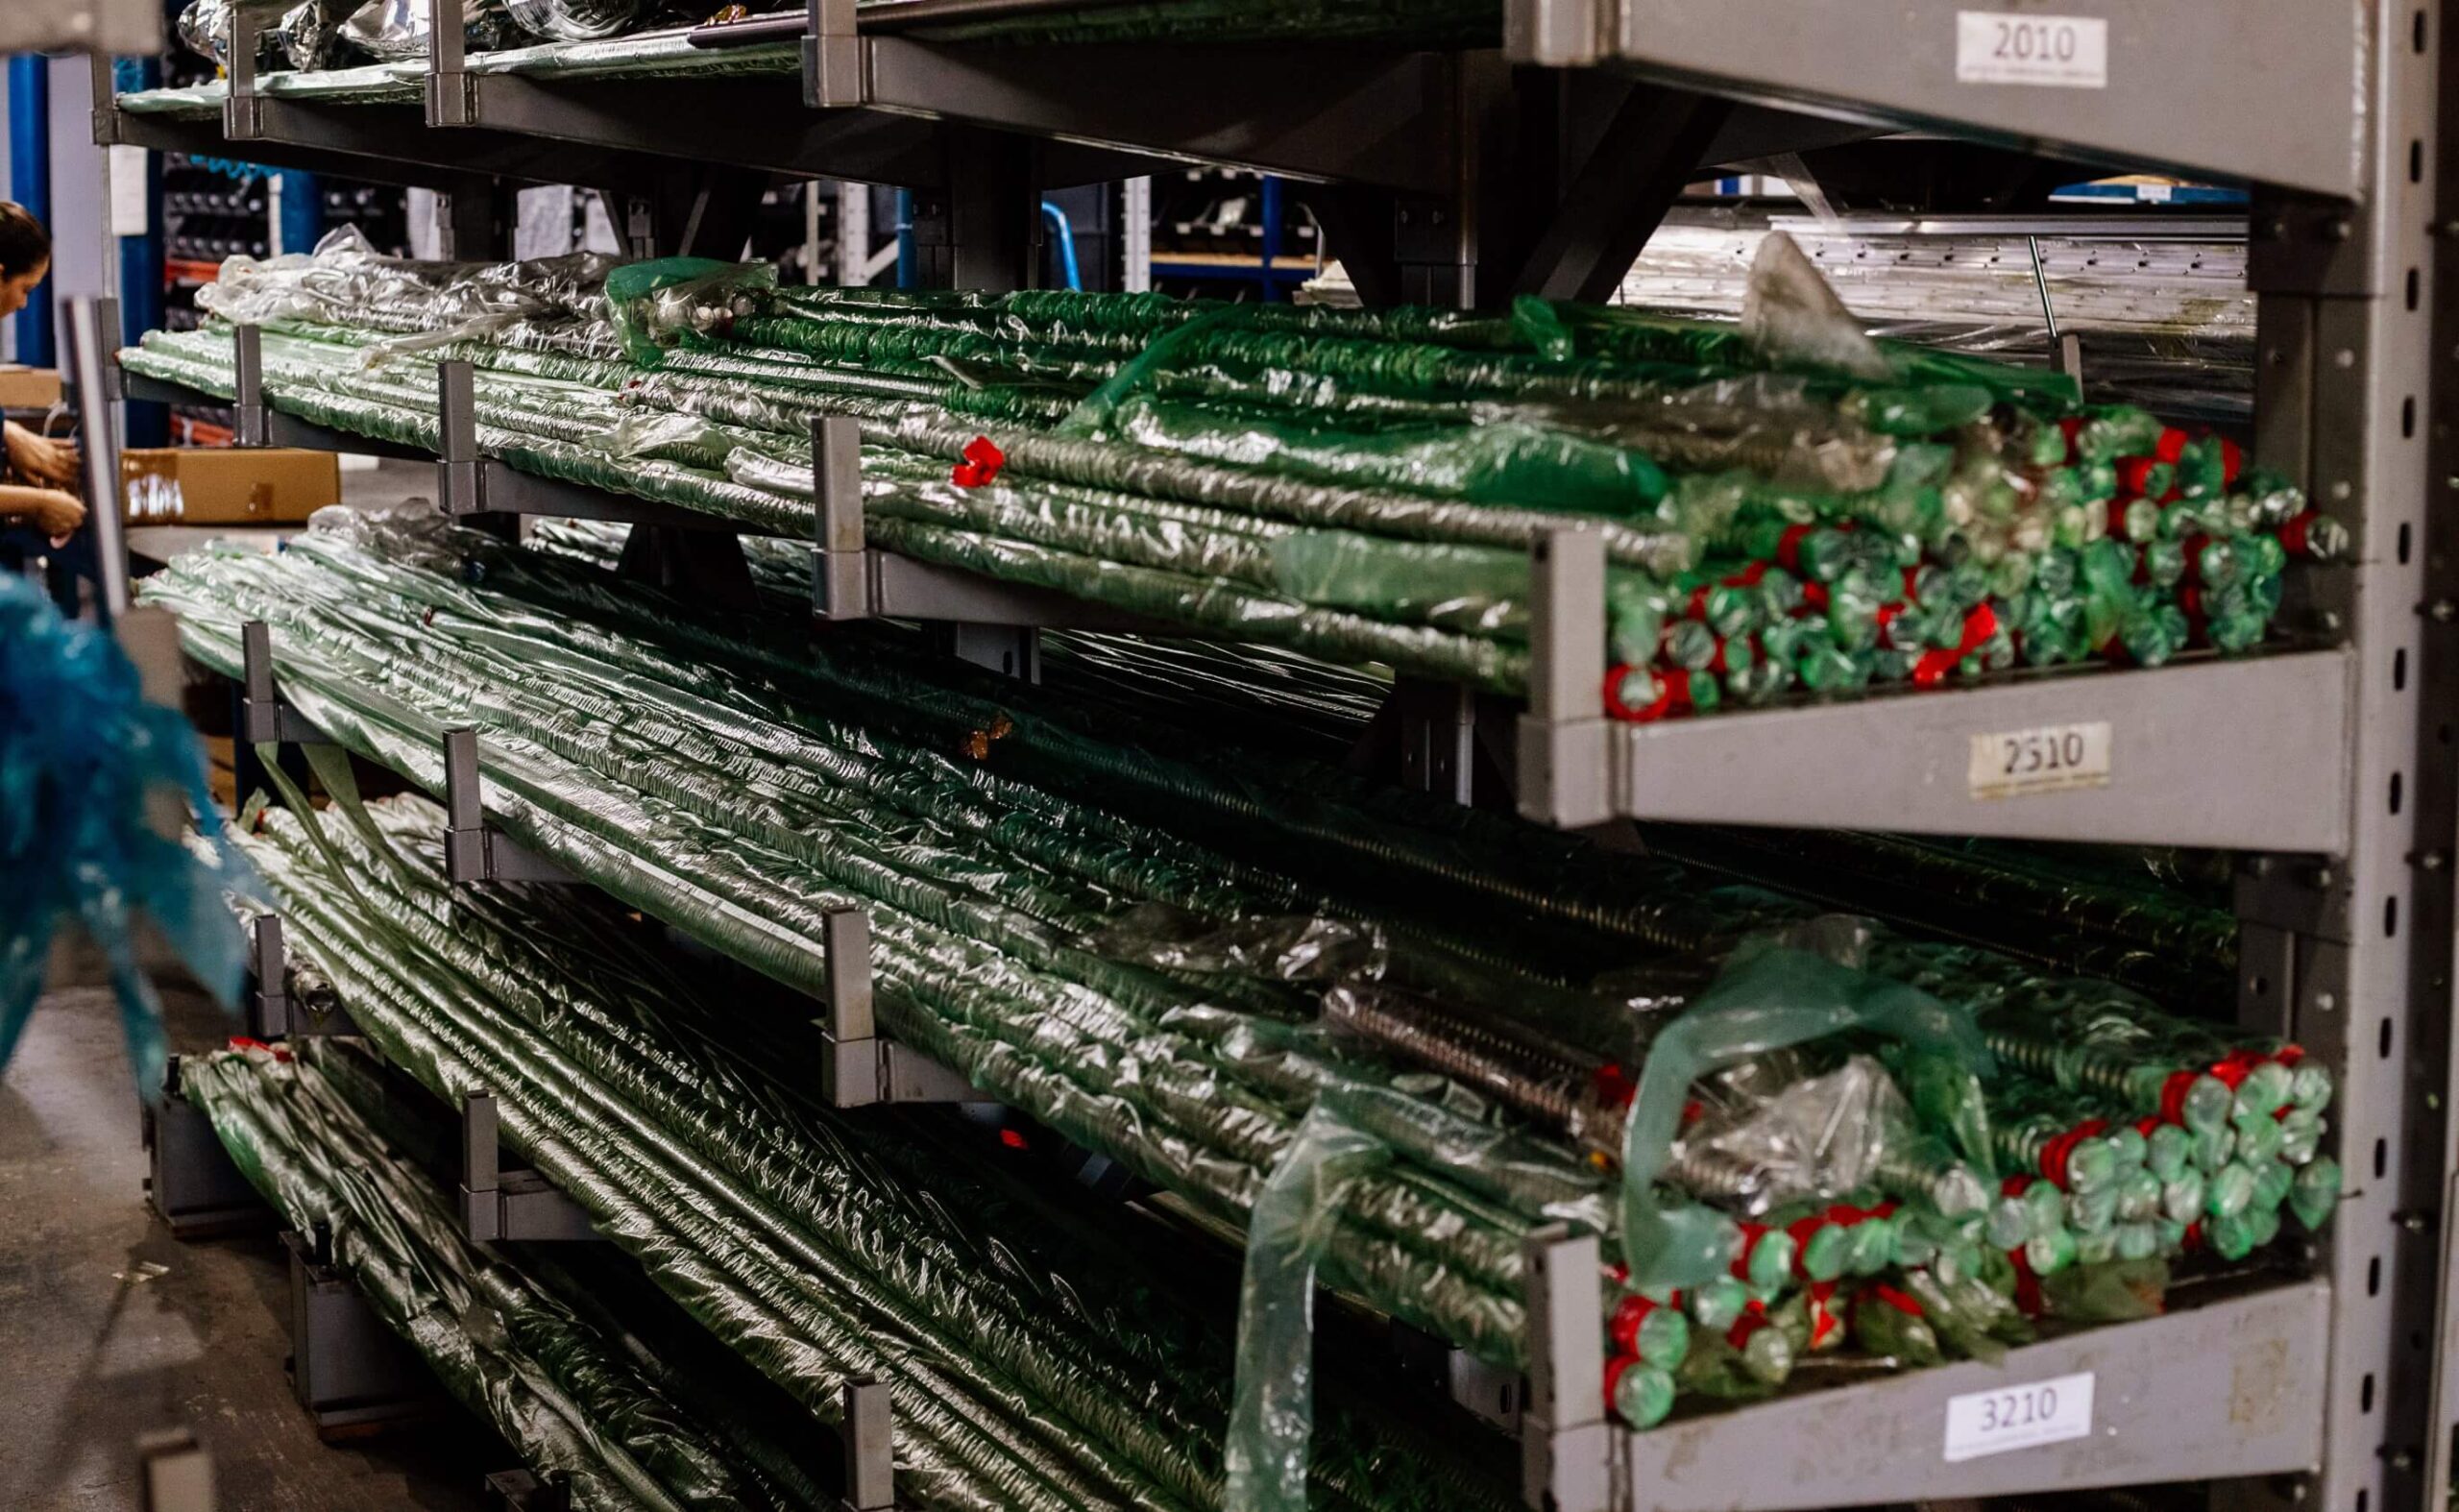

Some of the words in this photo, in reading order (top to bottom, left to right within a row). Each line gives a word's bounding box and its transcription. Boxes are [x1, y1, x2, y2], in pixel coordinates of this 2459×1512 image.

[1993, 21, 2076, 61] 2010
[2004, 732, 2083, 774] 2510
[1981, 1387, 2057, 1431] 3210
